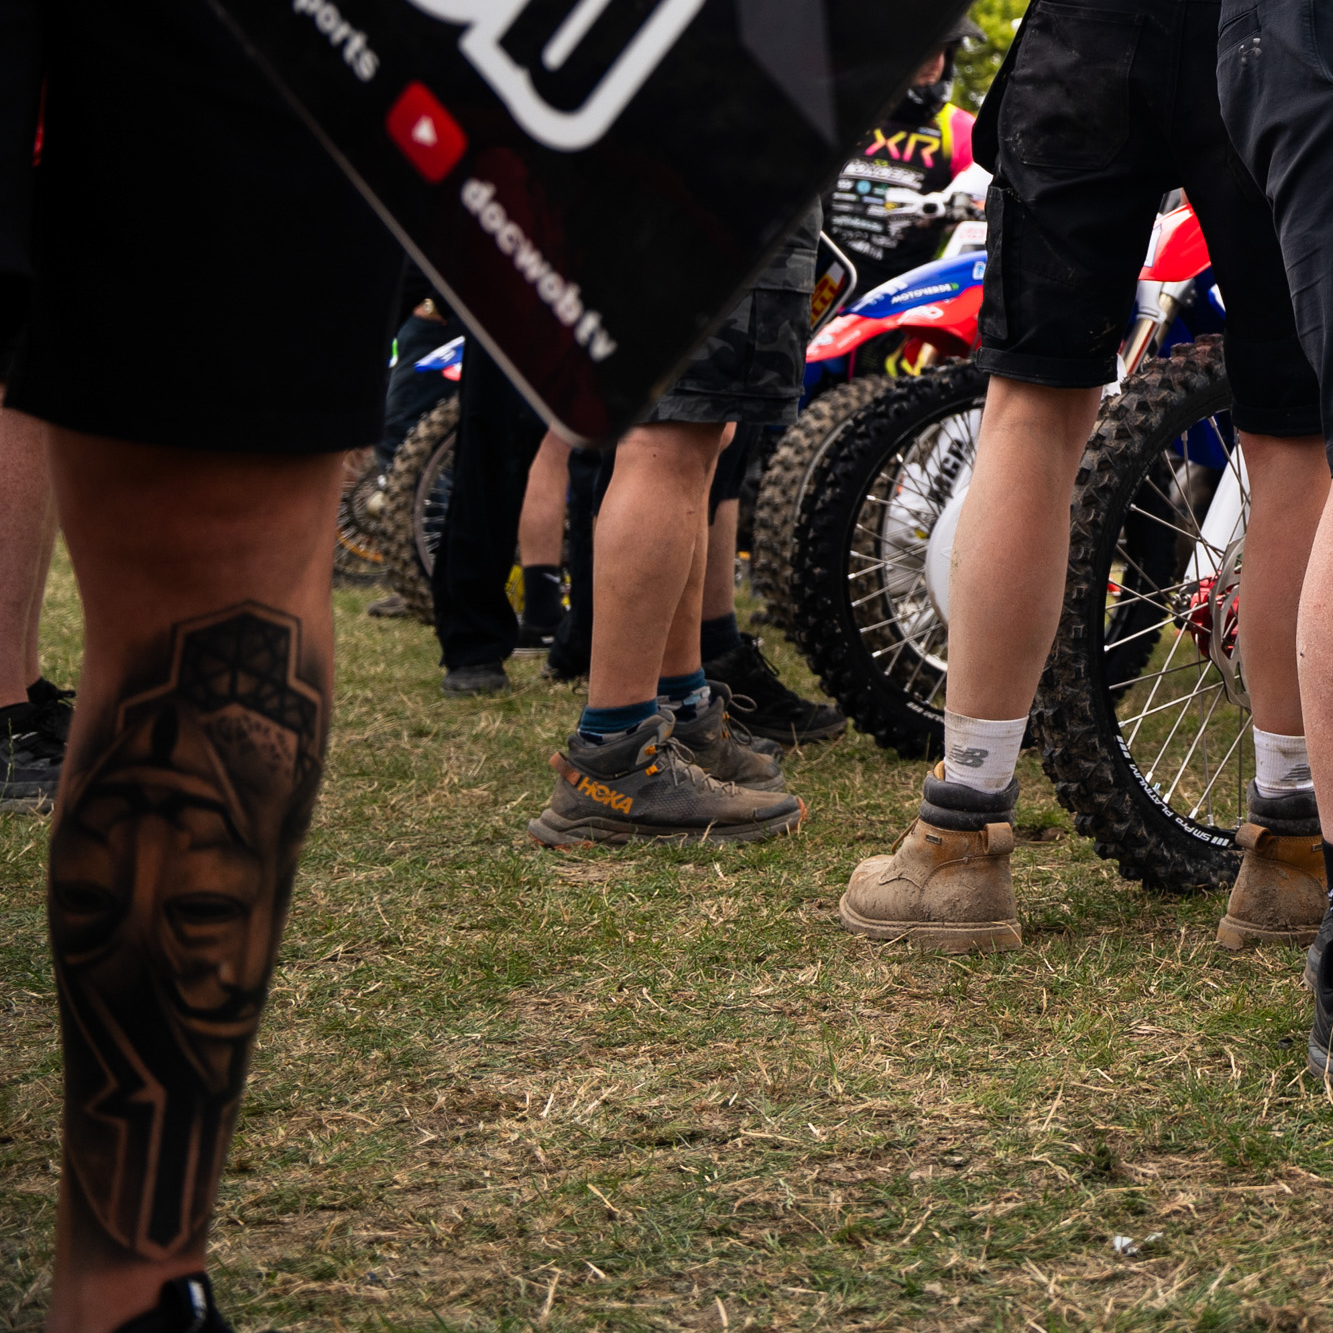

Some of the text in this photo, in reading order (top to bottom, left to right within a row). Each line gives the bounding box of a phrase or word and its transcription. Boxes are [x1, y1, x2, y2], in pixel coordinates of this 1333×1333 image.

[460, 177, 618, 362] docwobtv
[577, 776, 634, 815] HOKA
[1129, 763, 1173, 817] PLATINUM
